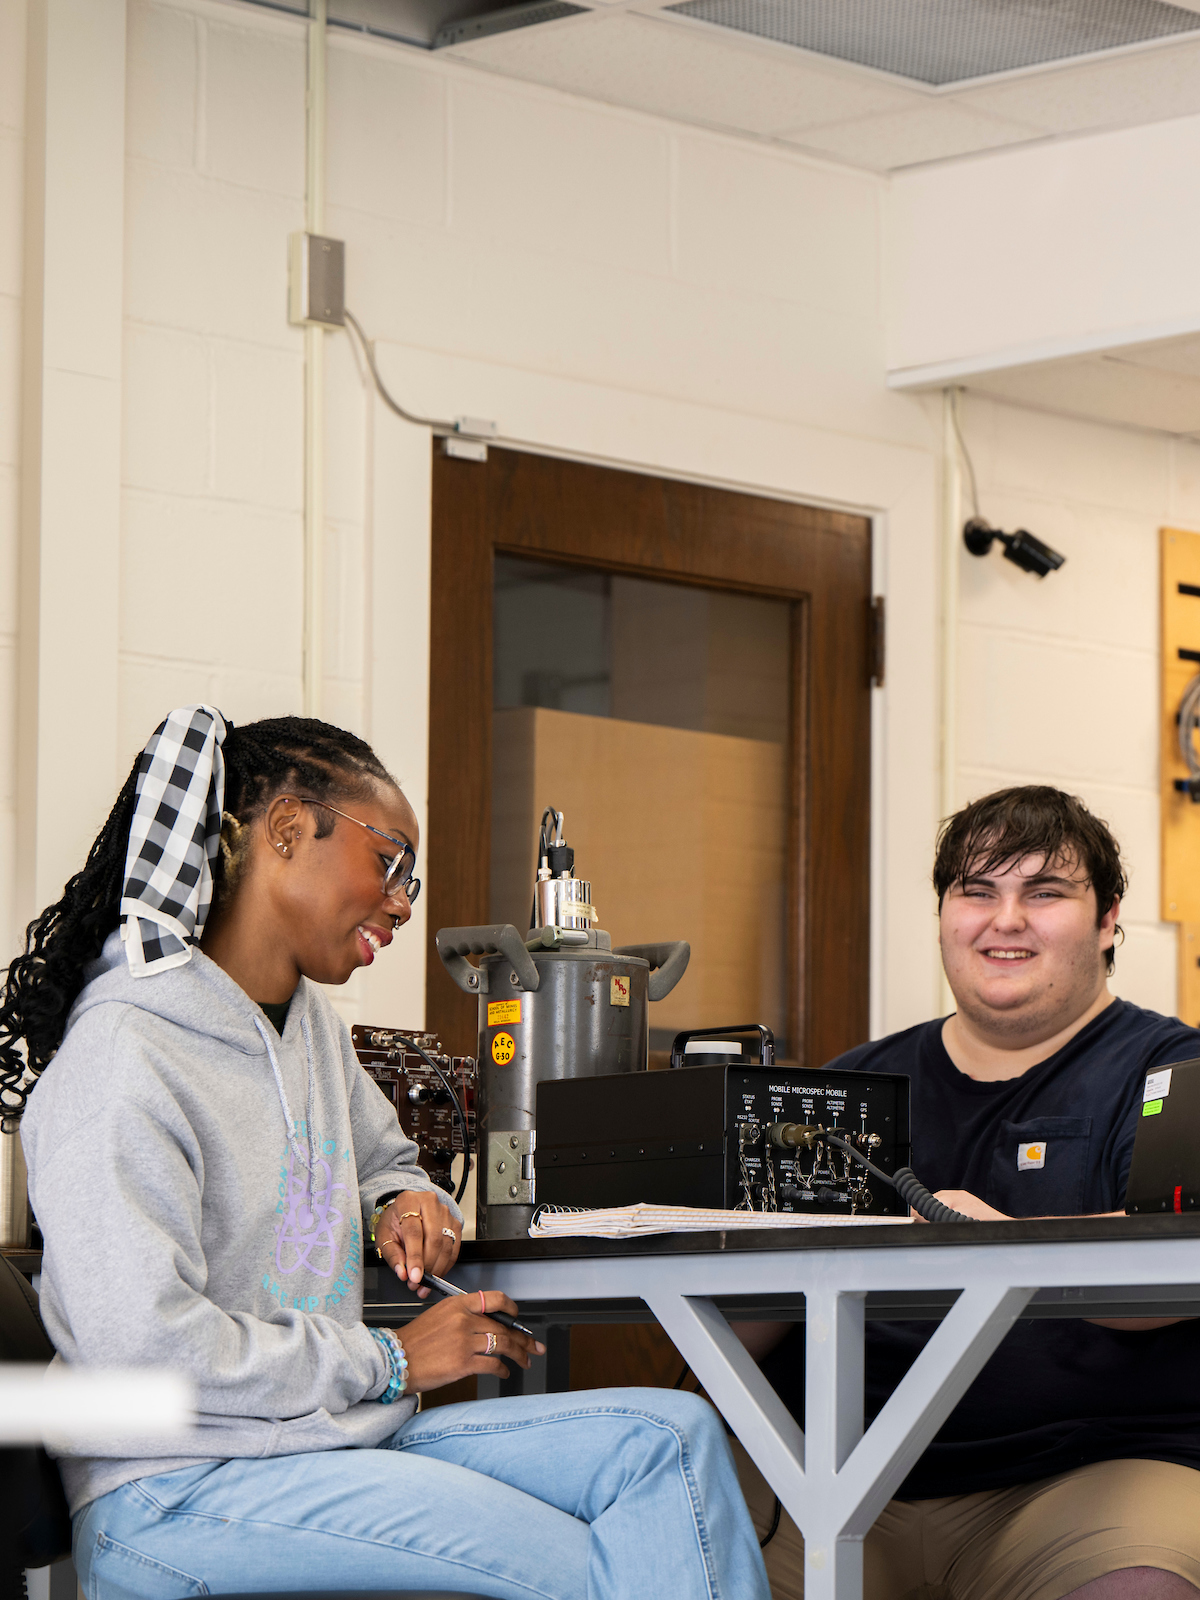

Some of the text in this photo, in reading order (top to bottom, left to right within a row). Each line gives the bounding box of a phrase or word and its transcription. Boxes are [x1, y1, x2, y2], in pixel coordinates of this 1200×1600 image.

[494, 1037, 513, 1049] AEC
[495, 1052, 510, 1061] G-30
[768, 1084, 847, 1098] MOBILE MICROSPEC MOBILE
[261, 1273, 288, 1308] AKE
[294, 1295, 319, 1312] UP
